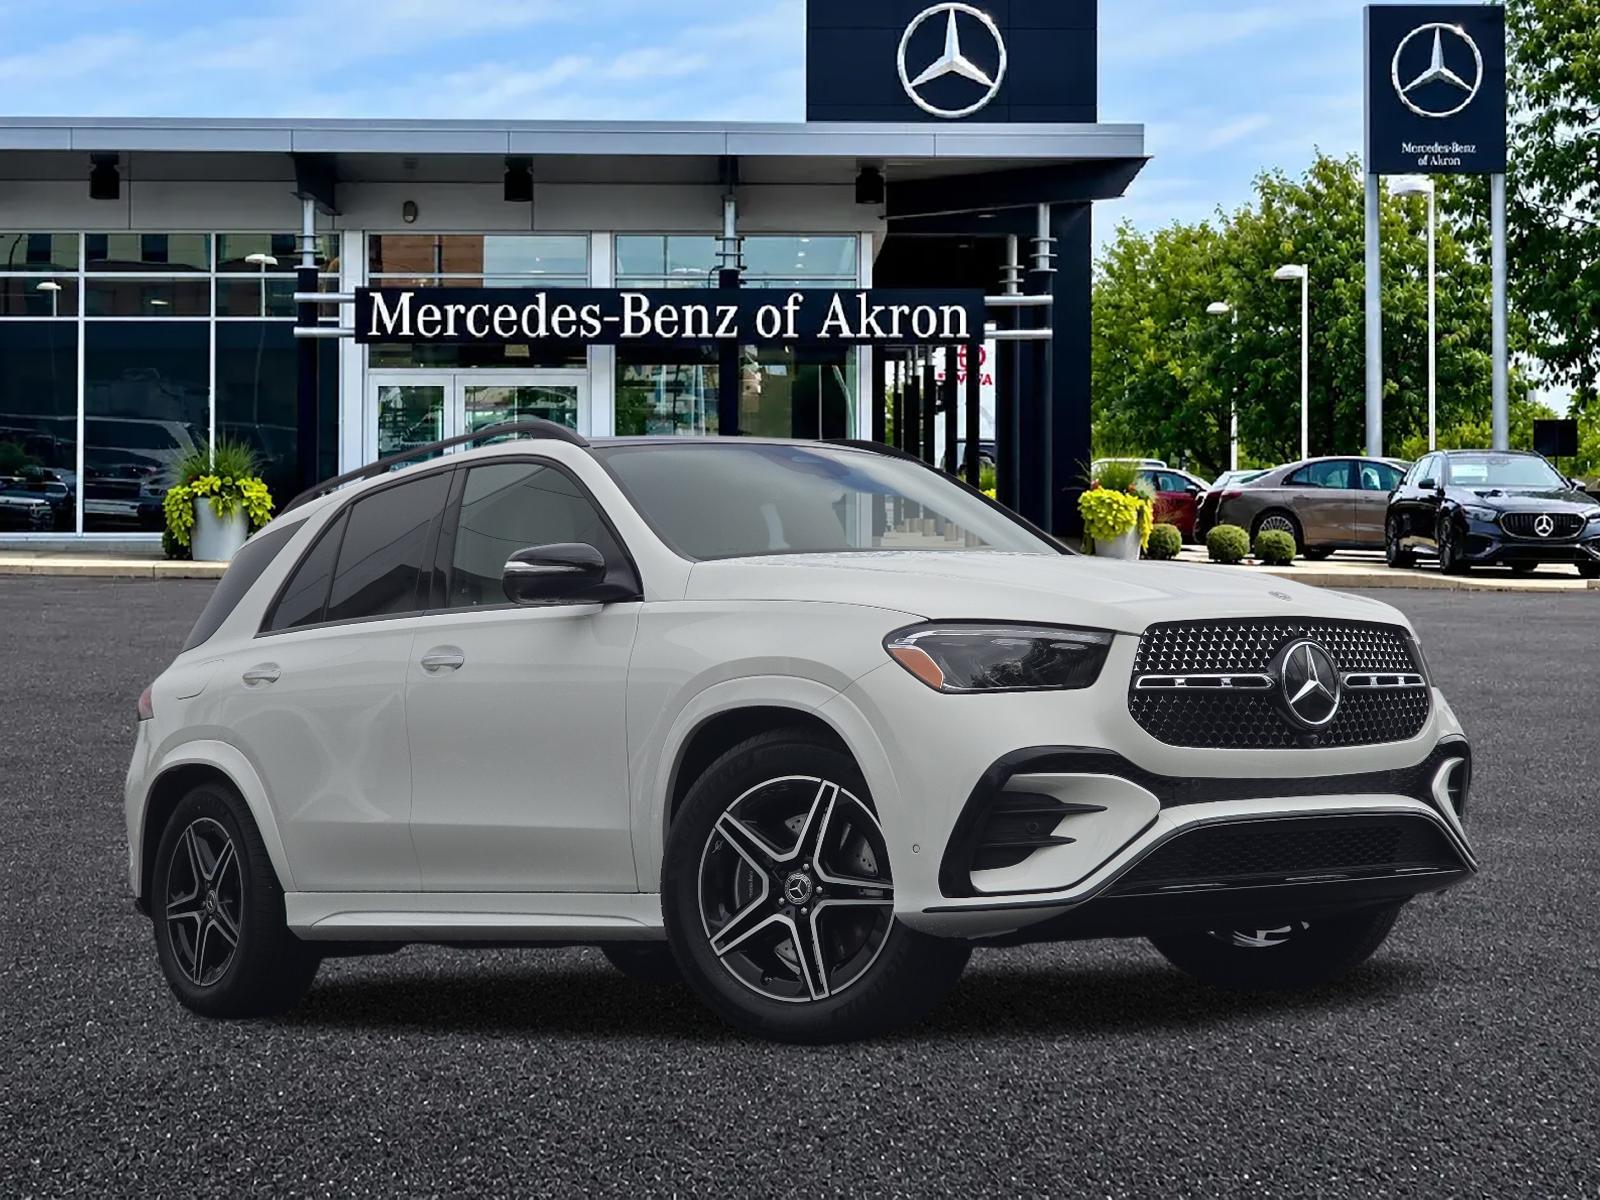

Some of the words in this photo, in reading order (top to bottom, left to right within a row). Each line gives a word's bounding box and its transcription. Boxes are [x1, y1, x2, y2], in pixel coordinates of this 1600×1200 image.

[1401, 141, 1477, 154] Mercedes-Benz
[1417, 154, 1428, 166] of
[1430, 154, 1461, 166] Akron
[367, 291, 738, 339] Mercedes-Benz
[755, 291, 804, 339] of
[816, 292, 970, 339] Akron
